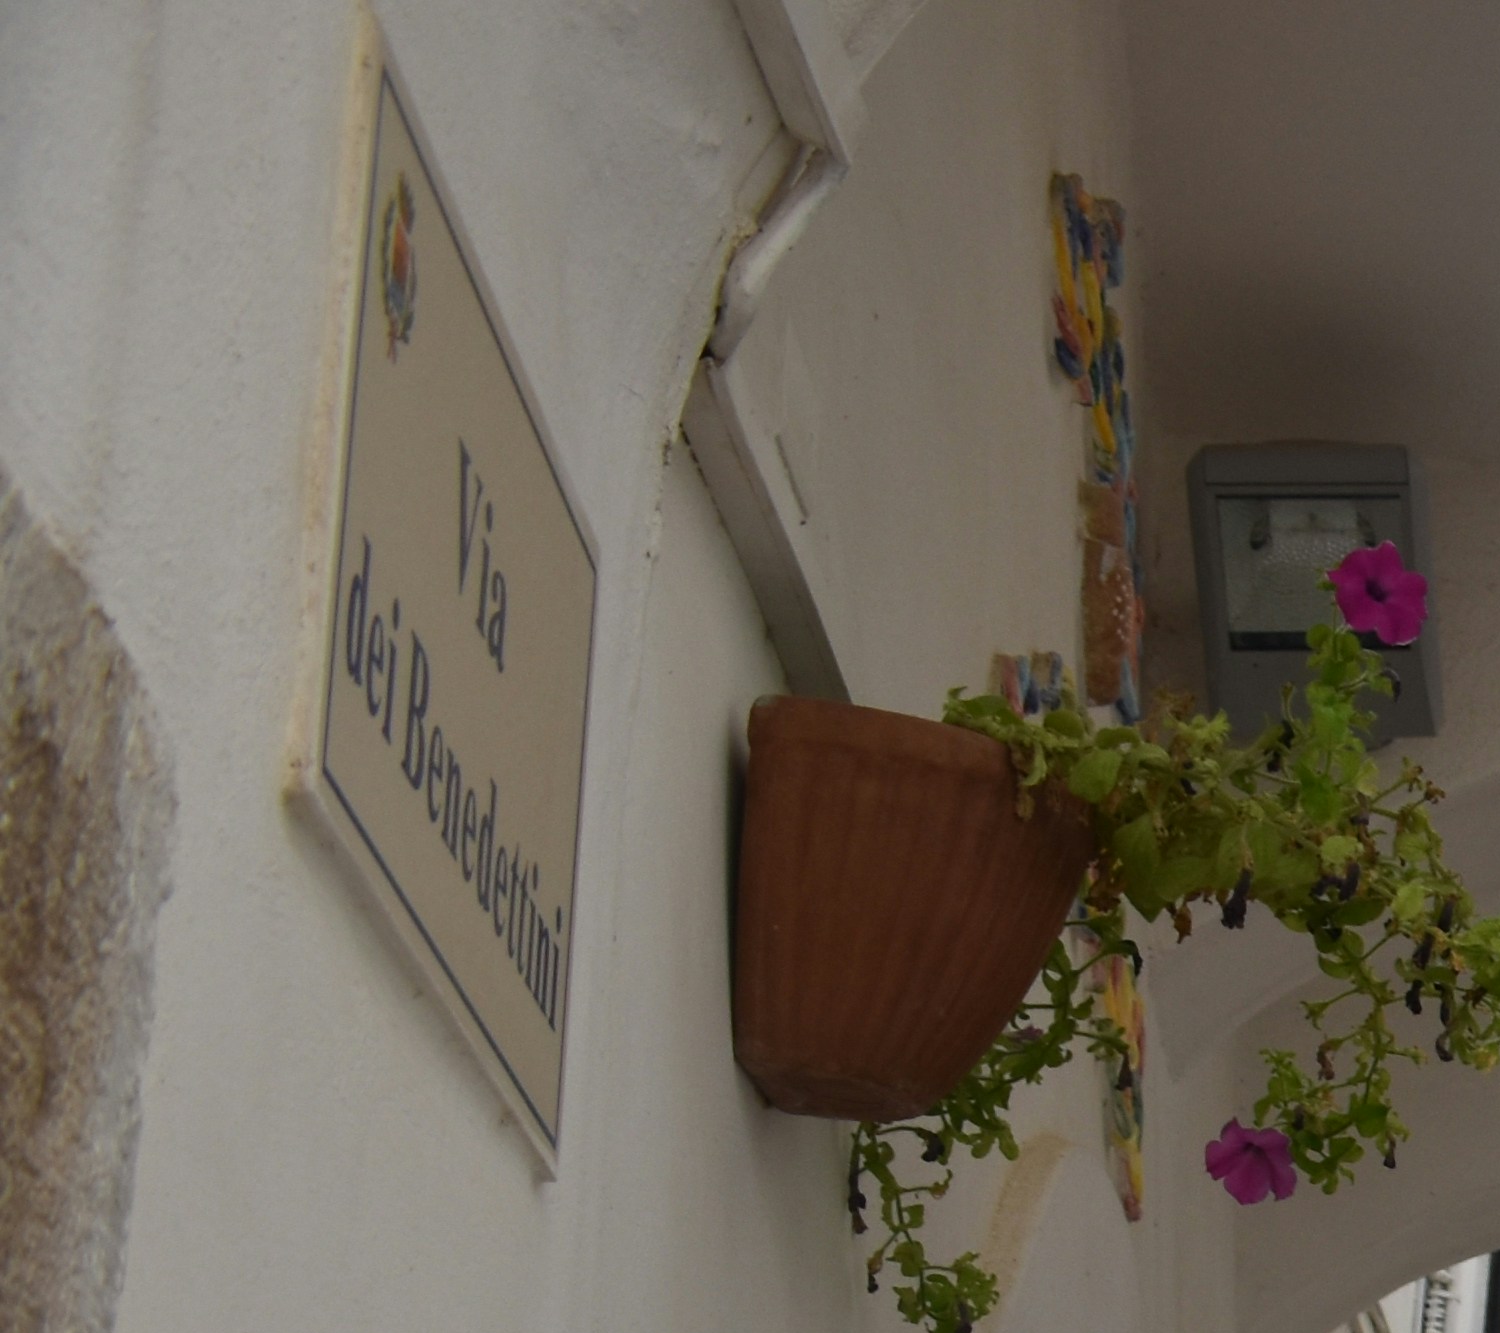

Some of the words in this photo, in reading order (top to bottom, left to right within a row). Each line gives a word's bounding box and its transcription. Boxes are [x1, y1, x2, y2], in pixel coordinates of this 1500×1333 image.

[459, 436, 507, 674] Via
[347, 533, 401, 746] dei
[401, 629, 563, 1033] Benedettini
